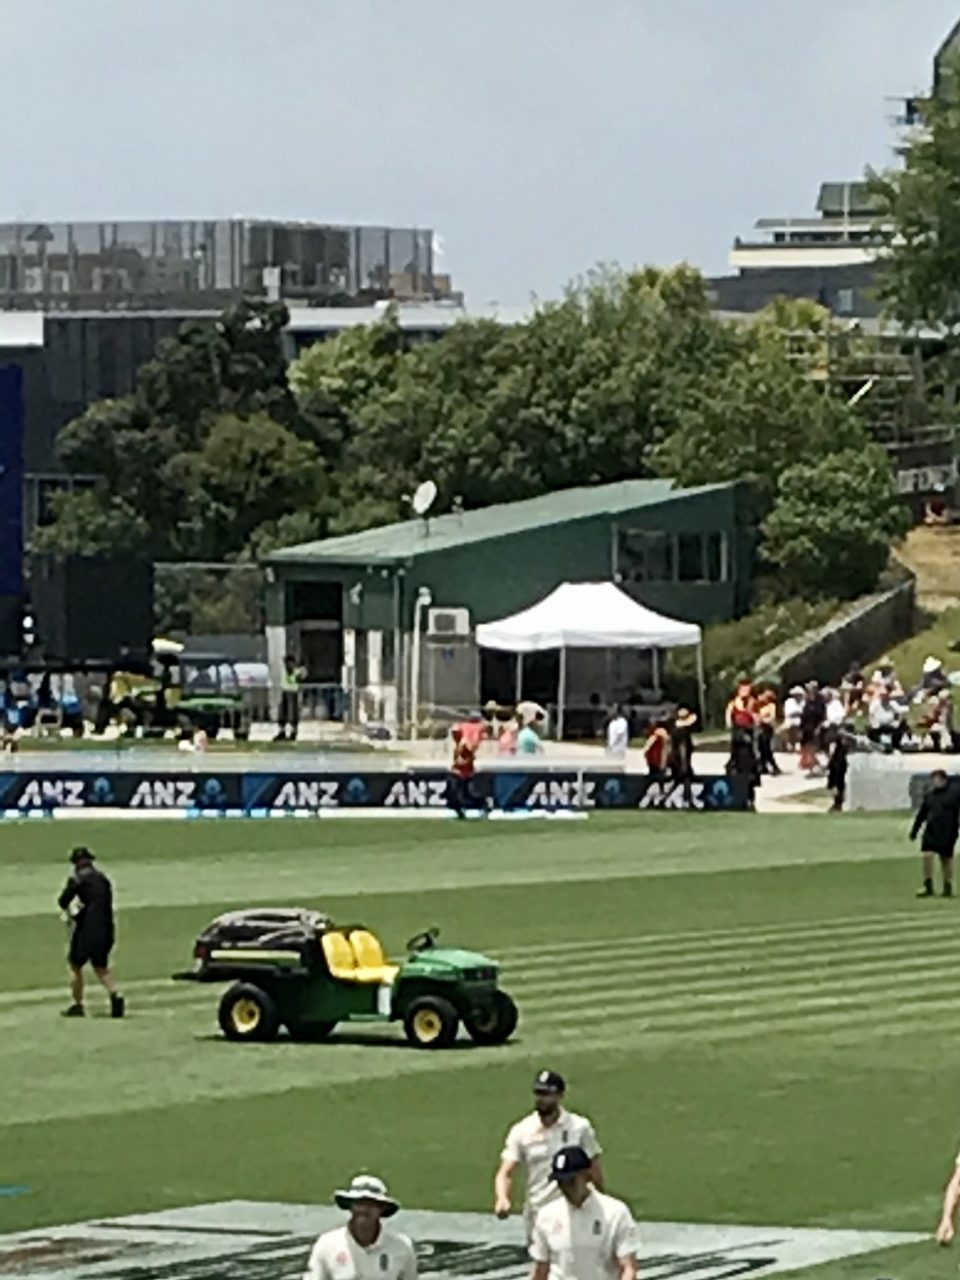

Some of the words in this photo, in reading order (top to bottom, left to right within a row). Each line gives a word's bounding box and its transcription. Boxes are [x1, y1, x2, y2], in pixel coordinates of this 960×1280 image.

[18, 780, 84, 807] ANZ
[129, 780, 196, 807] ANZ
[273, 780, 339, 807] ANZ
[384, 780, 447, 806] ANZ
[526, 781, 595, 807] ANZ
